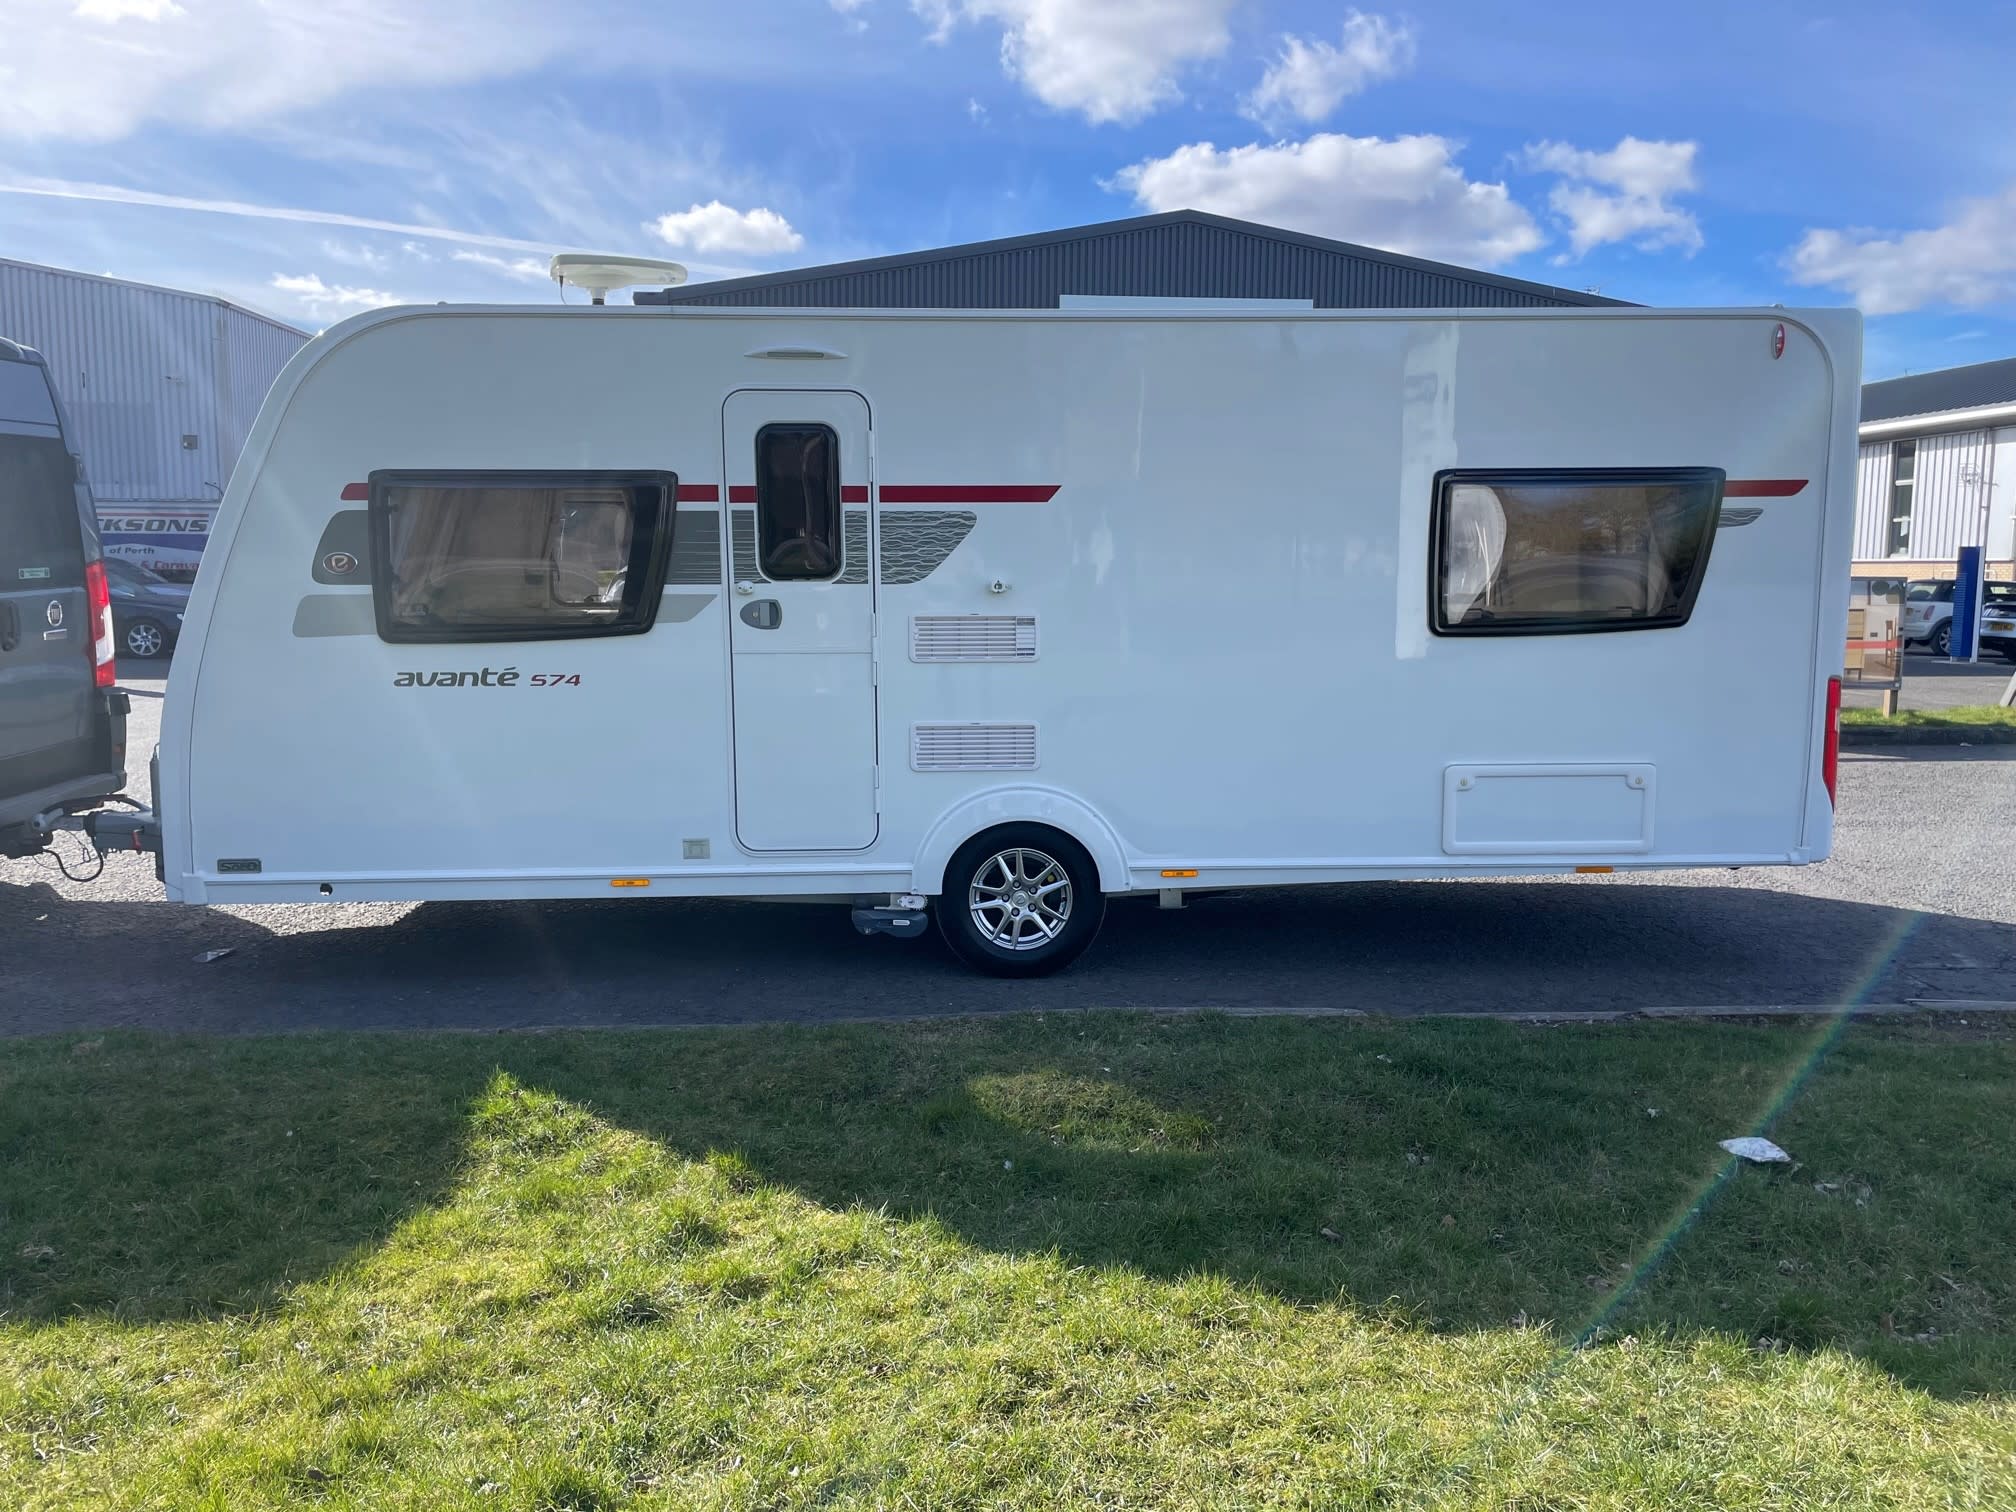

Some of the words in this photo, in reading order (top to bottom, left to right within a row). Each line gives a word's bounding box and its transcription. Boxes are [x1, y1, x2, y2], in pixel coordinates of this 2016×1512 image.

[97, 519, 208, 532] KSONS
[124, 547, 155, 555] Perth
[393, 666, 520, 687] avanté
[529, 674, 582, 687] S74
